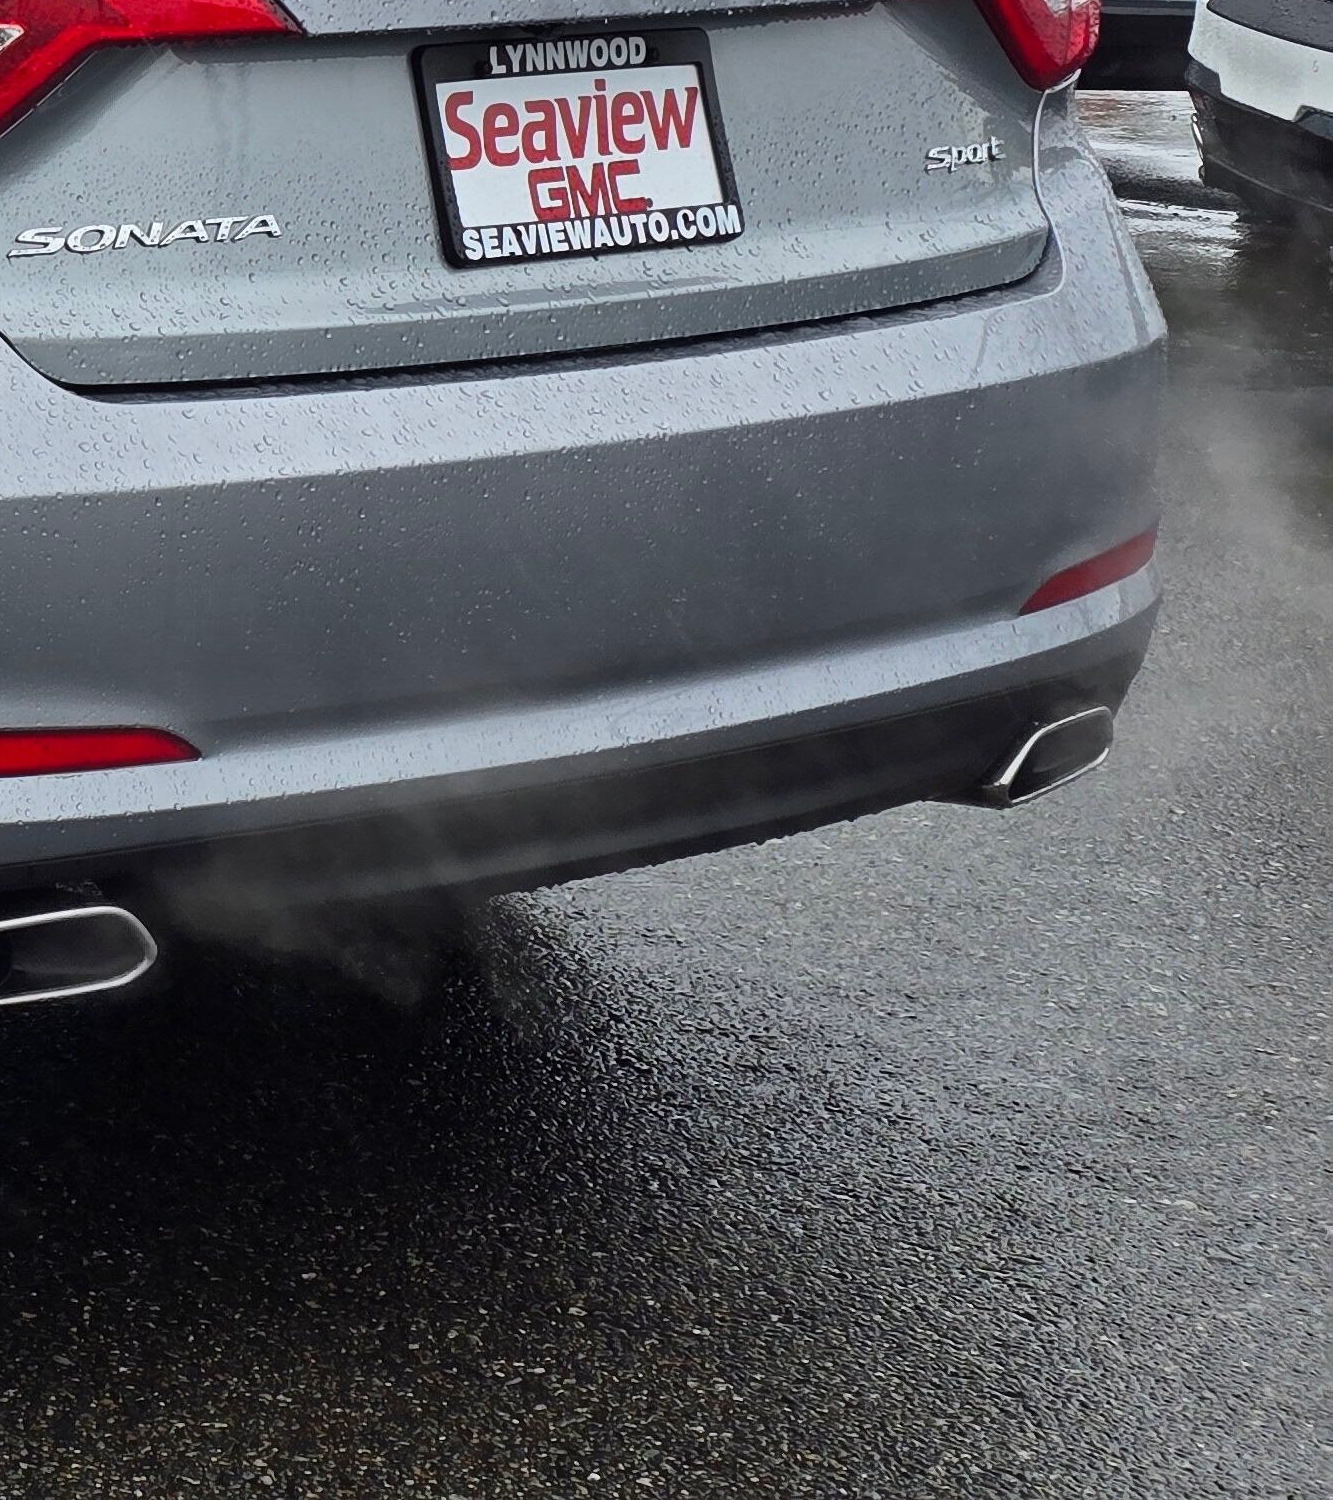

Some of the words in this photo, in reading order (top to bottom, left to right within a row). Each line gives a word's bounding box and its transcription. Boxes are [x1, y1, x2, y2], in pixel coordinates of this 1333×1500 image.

[489, 36, 647, 75] LYNNWOOD
[444, 78, 699, 171] Seaview
[925, 135, 1007, 172] Sport
[527, 159, 650, 222] GMC
[6, 214, 283, 258] SONATA
[462, 204, 742, 261] SEAVIEWAUTO.COM
